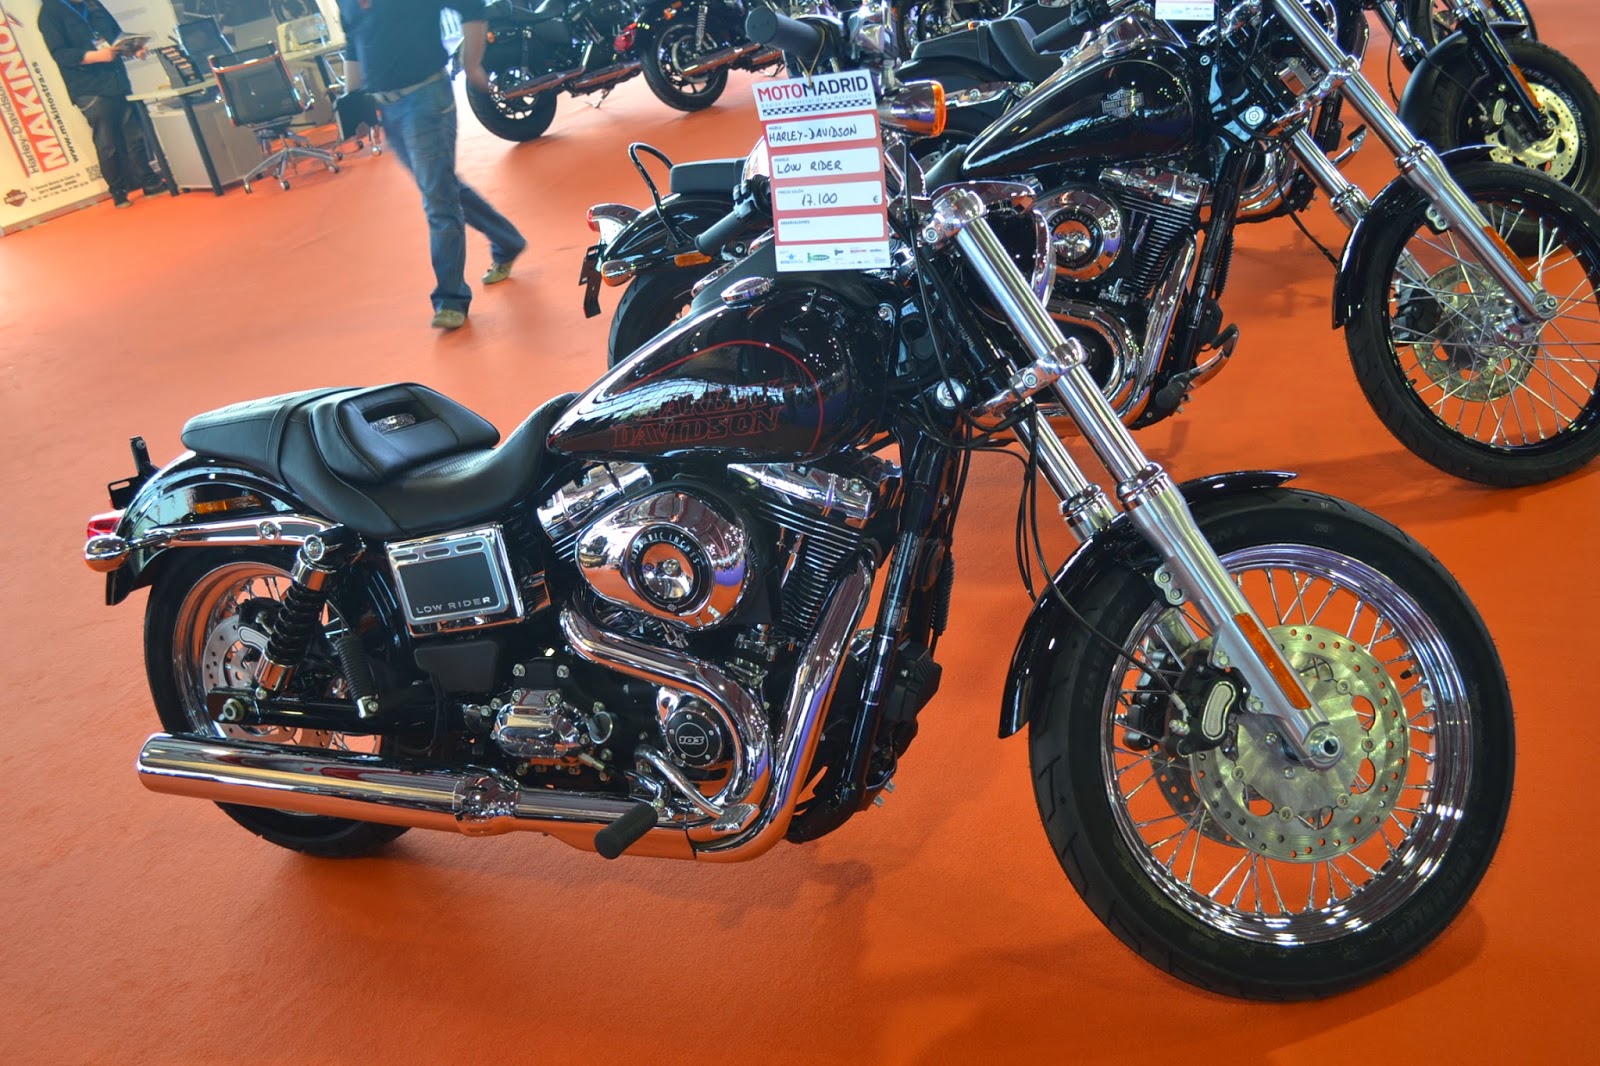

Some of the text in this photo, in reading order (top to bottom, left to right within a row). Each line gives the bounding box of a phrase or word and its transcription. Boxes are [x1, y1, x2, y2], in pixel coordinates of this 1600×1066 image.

[0, 12, 68, 171] MAKINO
[757, 76, 868, 102] MOTOMADRID
[32, 61, 79, 163] www.makinostra.es
[769, 123, 857, 143] HARLEY-DAVIDSON
[777, 160, 842, 174] LOW RIDER
[801, 193, 838, 206] 17.100
[610, 405, 783, 448] DAVIDSON
[669, 533, 699, 563] INCHES
[416, 596, 491, 614] LOW RIDER
[679, 735, 705, 745] 103
